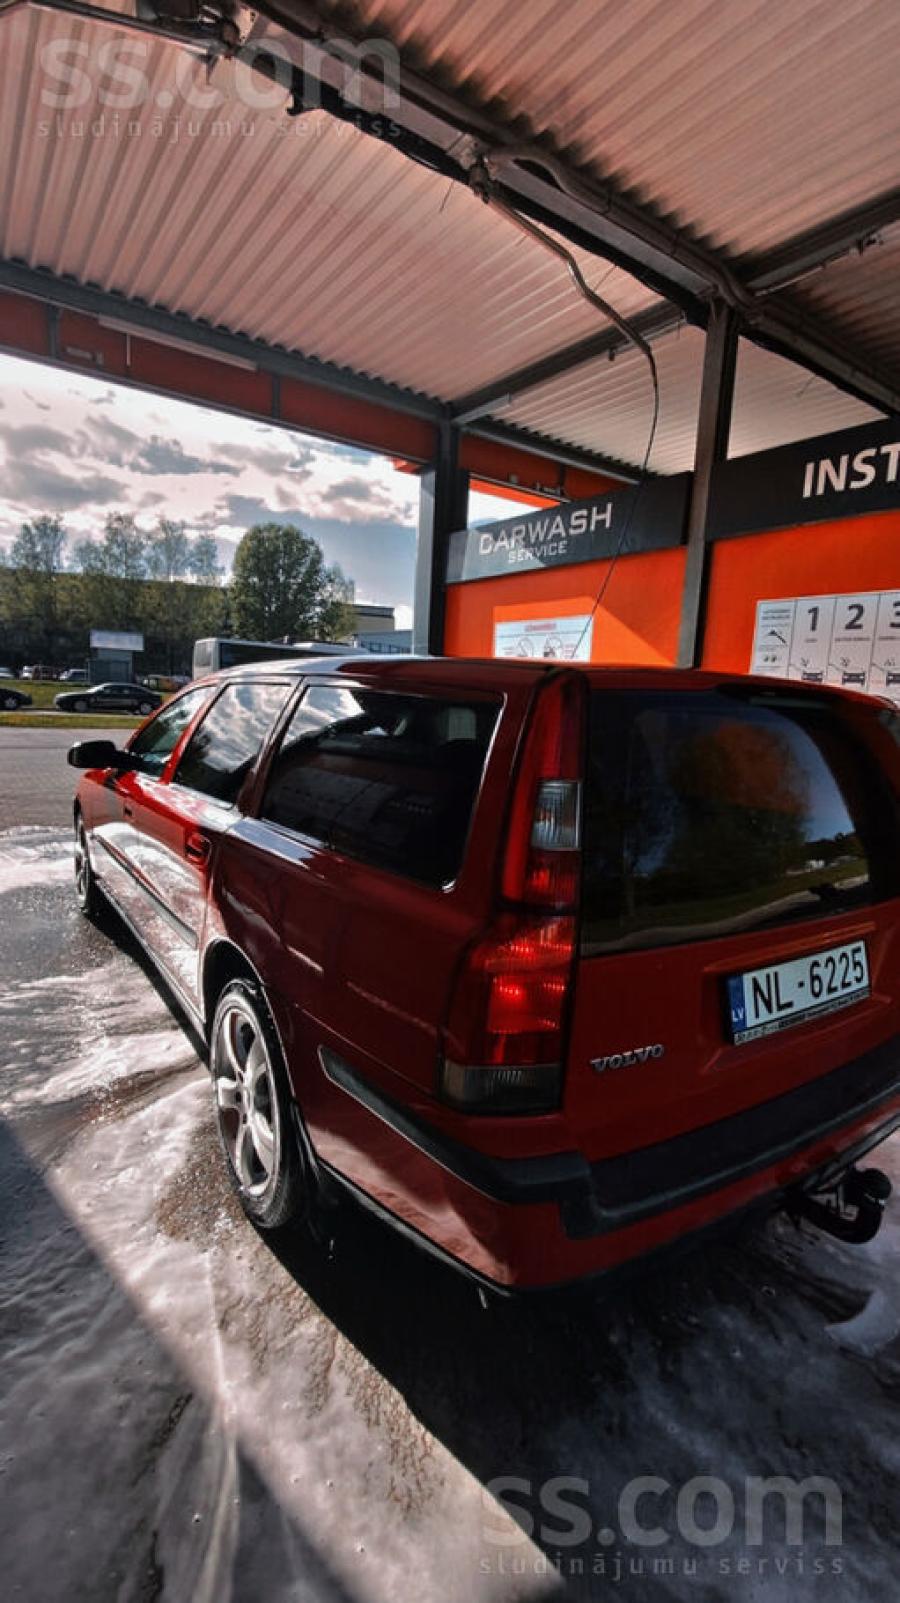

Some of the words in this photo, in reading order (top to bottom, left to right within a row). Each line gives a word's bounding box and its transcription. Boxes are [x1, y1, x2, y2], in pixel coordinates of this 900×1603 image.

[802, 441, 900, 499] INST
[478, 502, 614, 556] CARWASH
[507, 539, 569, 564] SERVICE
[807, 606, 820, 632] 1
[845, 603, 865, 630] 2
[731, 1007, 745, 1022] LV
[589, 1043, 665, 1073] VOLVO
